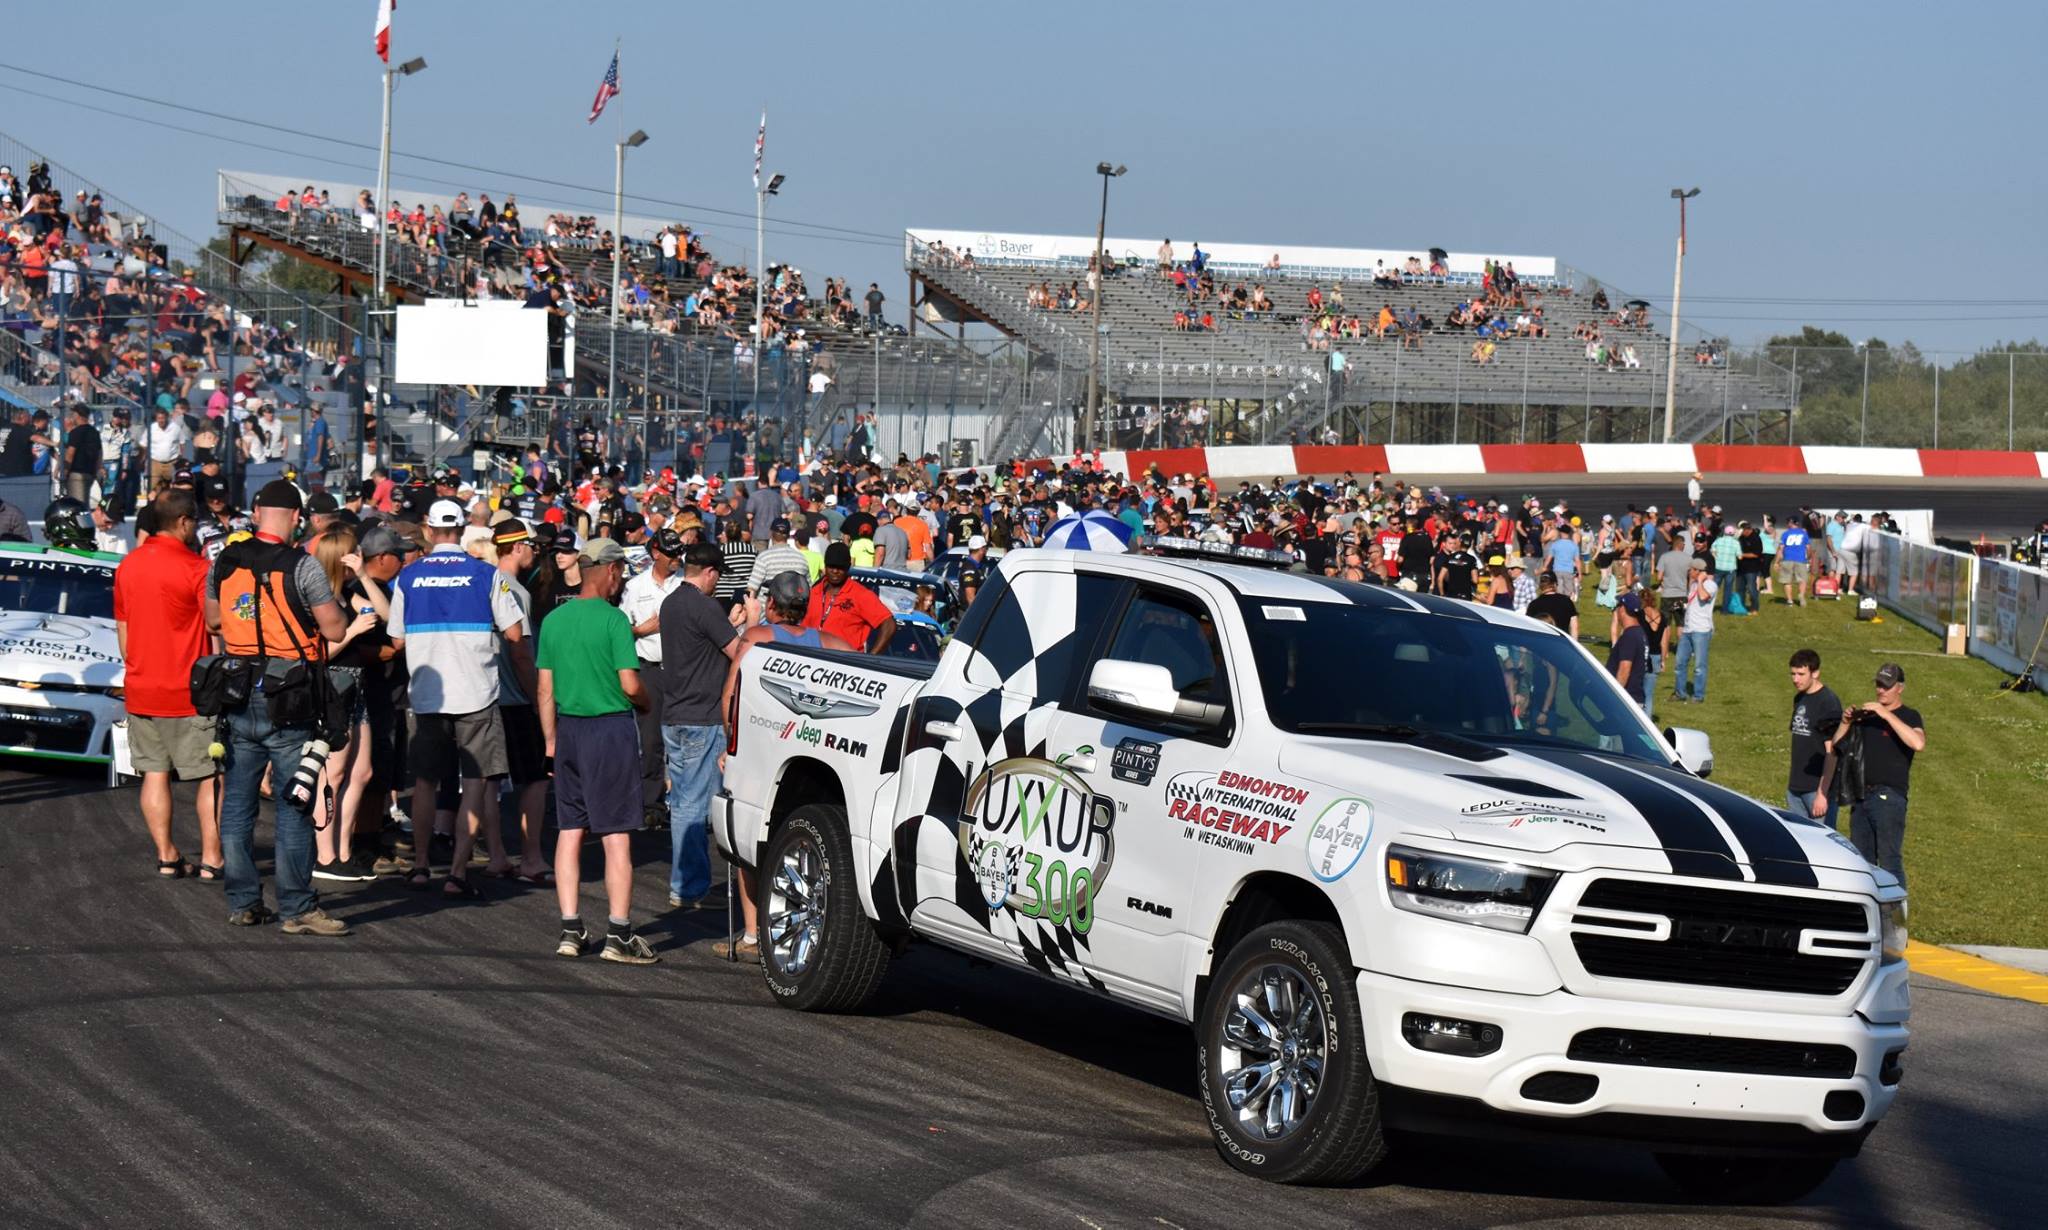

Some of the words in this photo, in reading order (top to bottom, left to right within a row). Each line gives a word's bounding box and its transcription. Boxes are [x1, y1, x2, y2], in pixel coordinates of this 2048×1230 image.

[1000, 239, 1033, 256] Bayer
[10, 559, 113, 578] PINTY'S
[412, 575, 473, 588] INDECK
[850, 575, 911, 588] PINTY'S
[762, 656, 811, 680] LEDUC
[810, 667, 888, 700] CHRYSLER
[750, 714, 788, 732] DODGE
[796, 719, 822, 748] Jeep
[824, 732, 869, 758] RAM
[1114, 750, 1156, 771] PINTY'S
[1217, 770, 1310, 806] EDMONTON
[1202, 787, 1298, 822] INTERNATIONAL
[1461, 800, 1516, 814] LEDUC
[1168, 797, 1292, 845] RACEWAY
[1528, 815, 1558, 824] Jeep
[1183, 826, 1195, 840] IN
[1197, 829, 1255, 856] WETASKIWIN
[1313, 823, 1364, 851] BAYER
[1321, 801, 1361, 876] BAYER
[980, 866, 1006, 883] BAYER
[1022, 851, 1095, 935] 300
[1127, 896, 1173, 920] RAM
[1270, 937, 1338, 1053] WRANGLER
